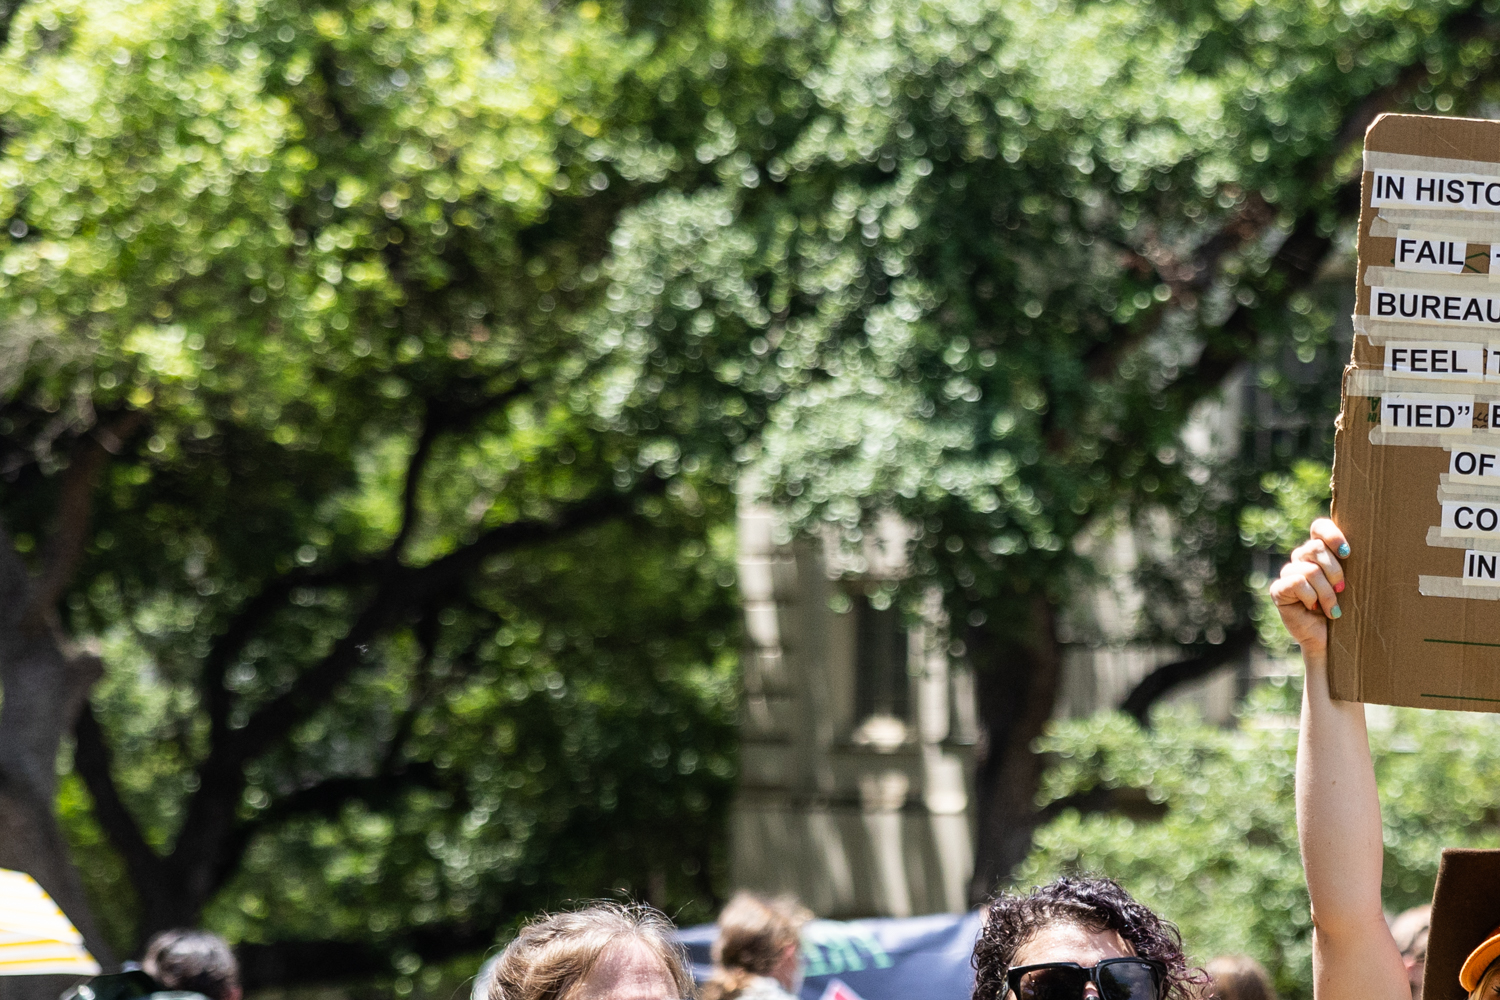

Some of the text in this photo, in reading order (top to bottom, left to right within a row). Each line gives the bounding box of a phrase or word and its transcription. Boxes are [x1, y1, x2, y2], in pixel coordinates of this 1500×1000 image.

[1376, 175, 1405, 200] IN
[1400, 239, 1464, 266] FAIL
[1392, 348, 1468, 373] FEEL
[1453, 450, 1498, 478] OF
[1468, 554, 1497, 579] IN
